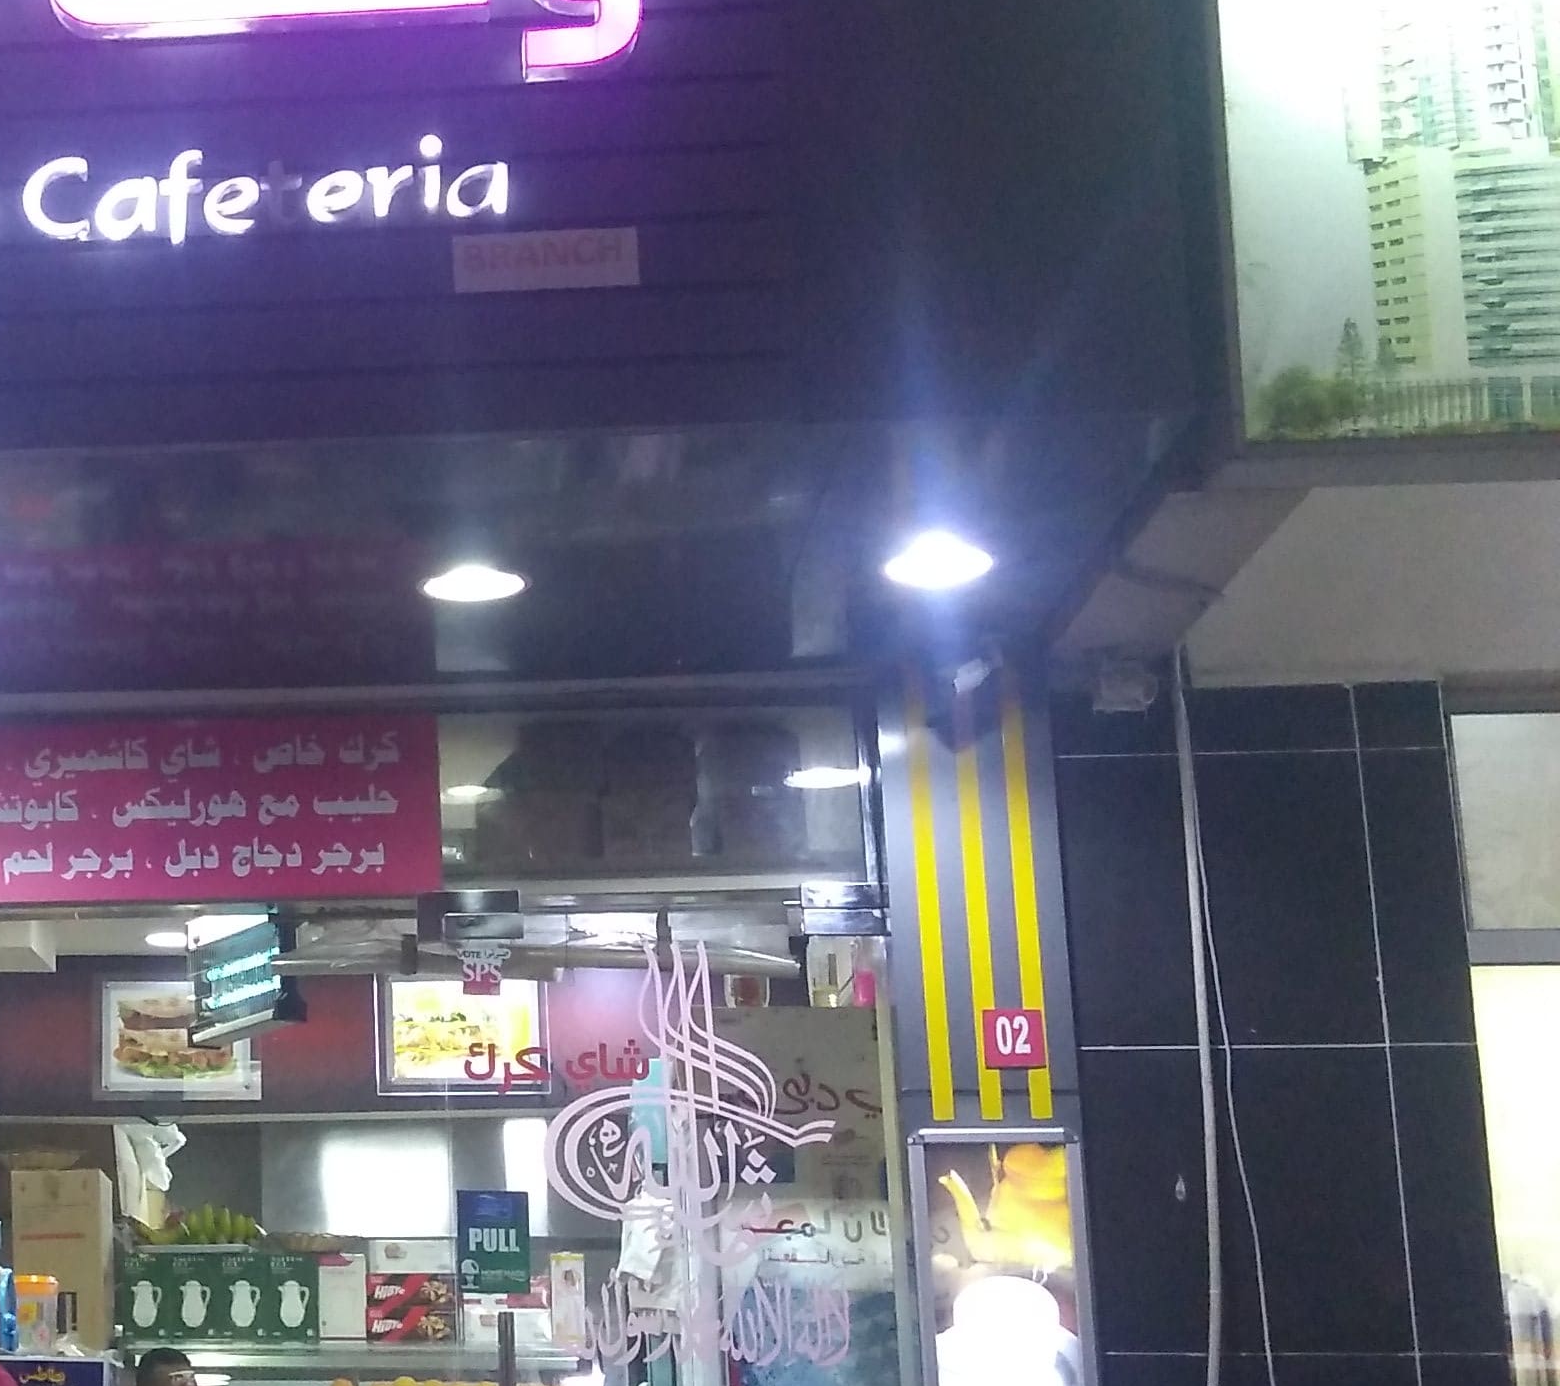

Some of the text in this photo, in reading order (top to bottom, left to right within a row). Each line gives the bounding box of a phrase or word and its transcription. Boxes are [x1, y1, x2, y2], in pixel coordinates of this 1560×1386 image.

[462, 963, 502, 983] SPS
[994, 1015, 1032, 1056] 02
[468, 1227, 521, 1253] PULL
